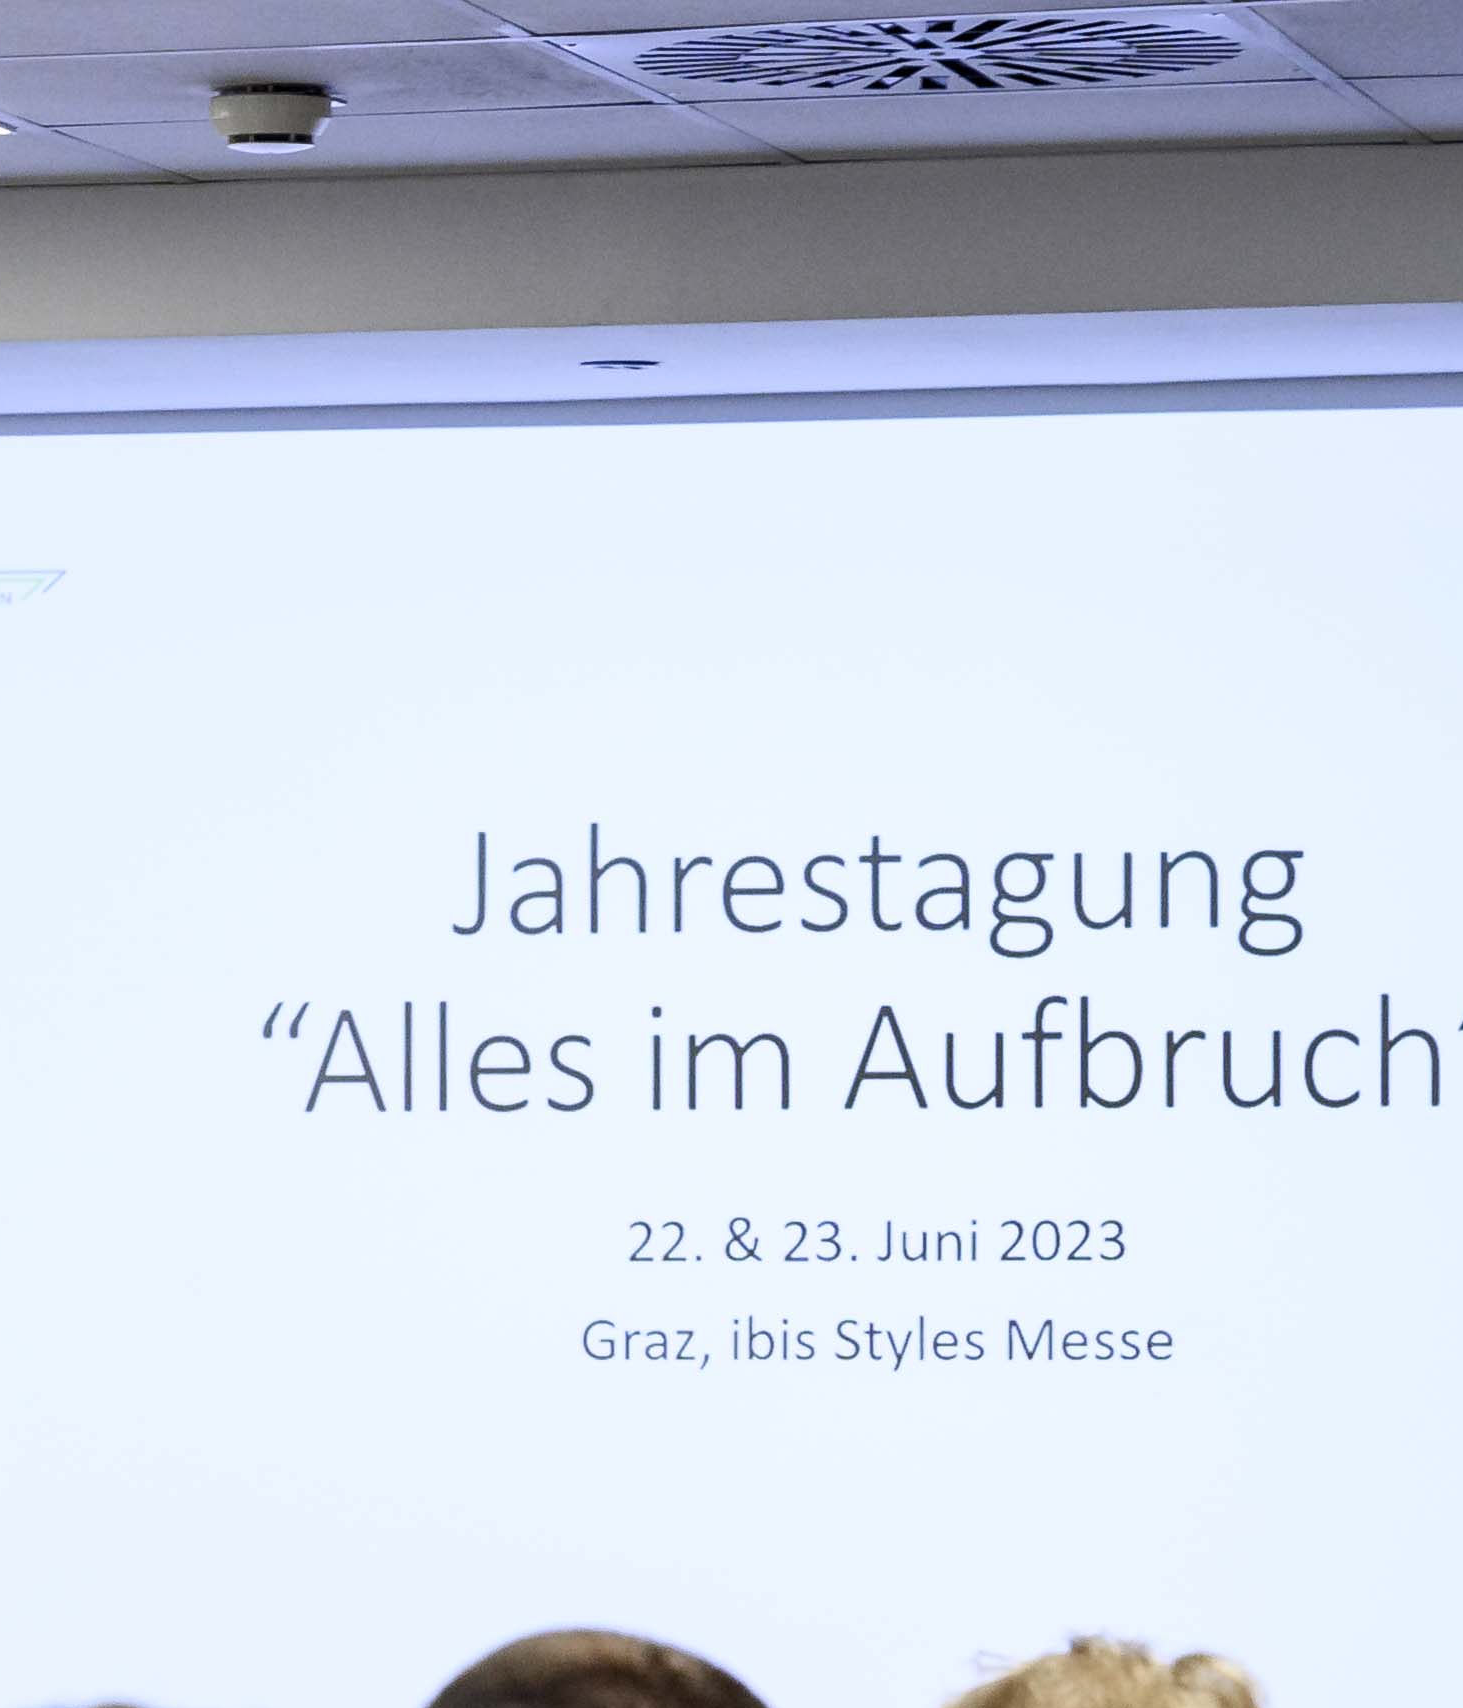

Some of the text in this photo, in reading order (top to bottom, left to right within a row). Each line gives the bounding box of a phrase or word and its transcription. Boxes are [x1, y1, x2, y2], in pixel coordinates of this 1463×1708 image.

[452, 822, 1305, 960] Jahrestagung
[260, 1000, 596, 1114] “Alles
[650, 1006, 792, 1112] im
[627, 1217, 1128, 1264] 22. & 23. Juni 2023
[580, 1314, 1175, 1372] Graz, ibis Styles Messe
